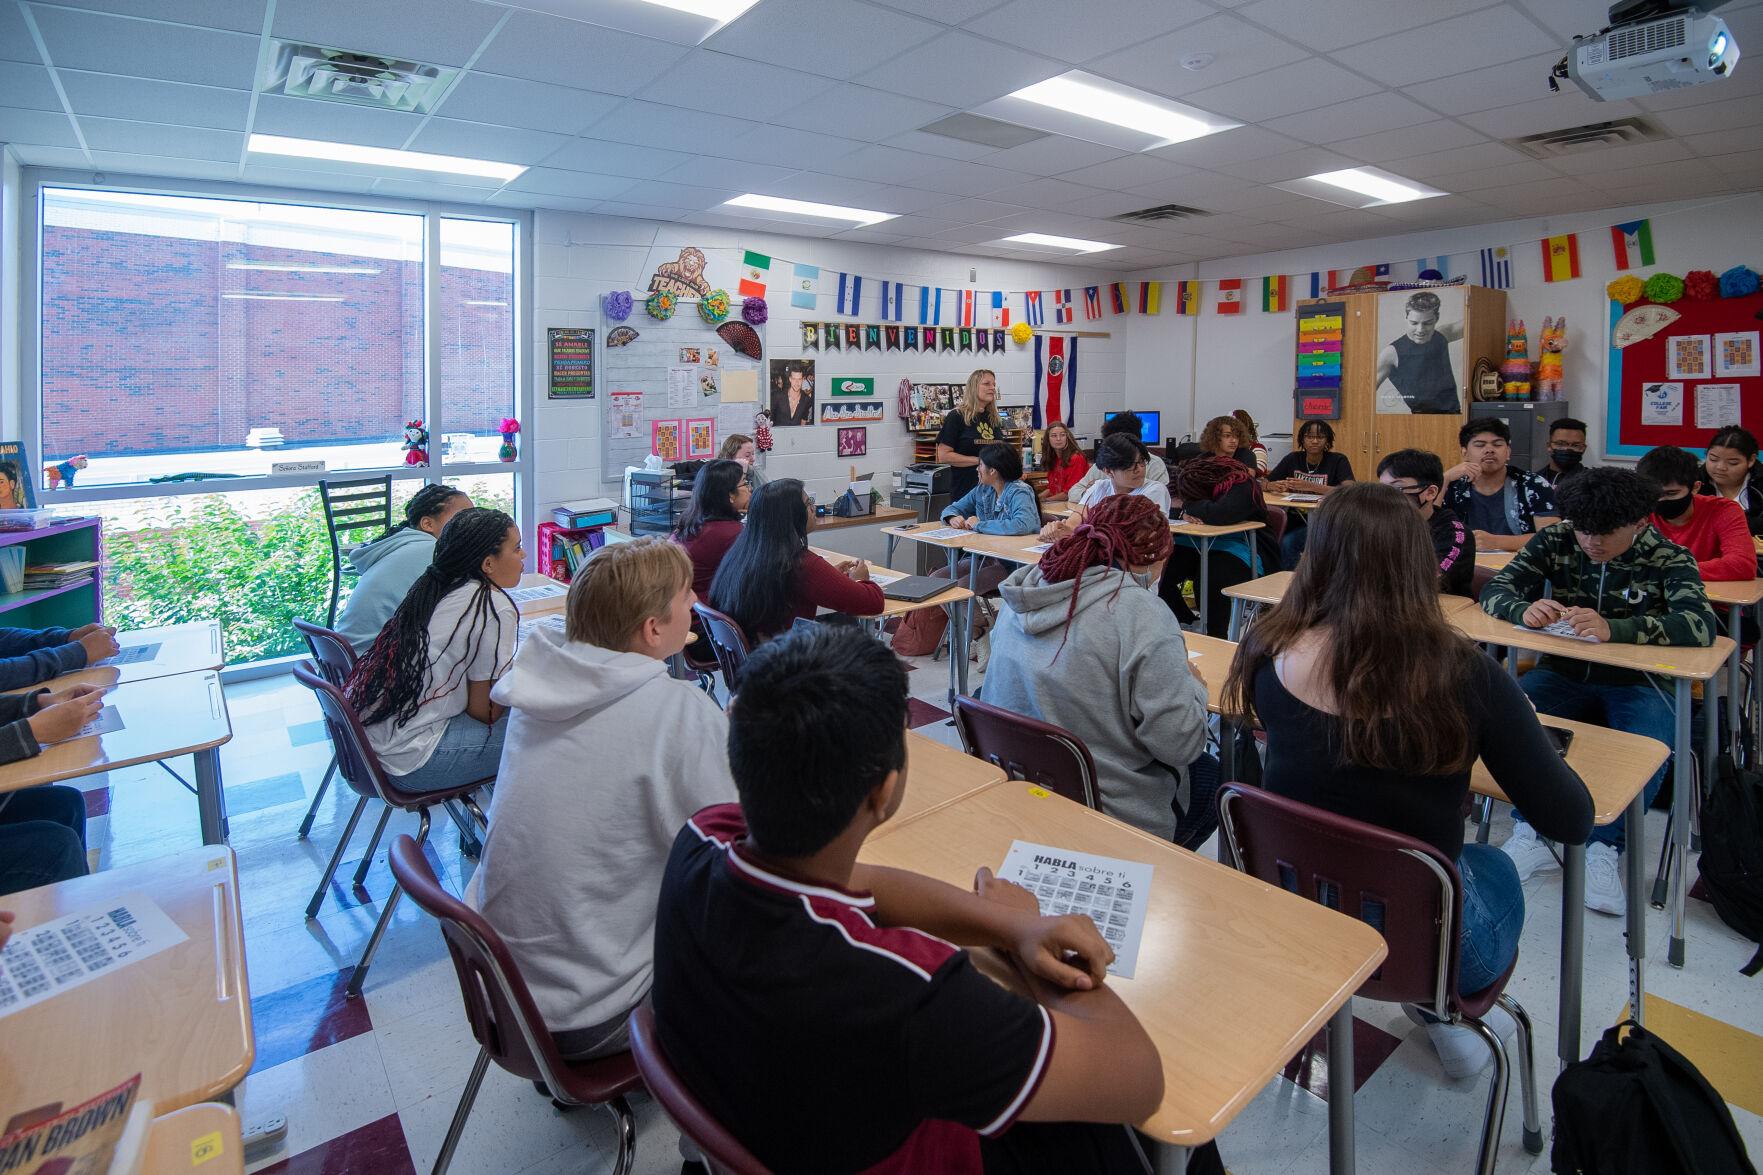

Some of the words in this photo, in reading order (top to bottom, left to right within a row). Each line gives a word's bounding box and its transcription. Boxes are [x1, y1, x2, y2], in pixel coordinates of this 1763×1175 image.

[805, 327, 1003, 345] BIENVENIDOS
[1034, 855, 1077, 870] HABLA
[1079, 865, 1114, 876] sobre
[42, 1087, 132, 1157] BROWN
